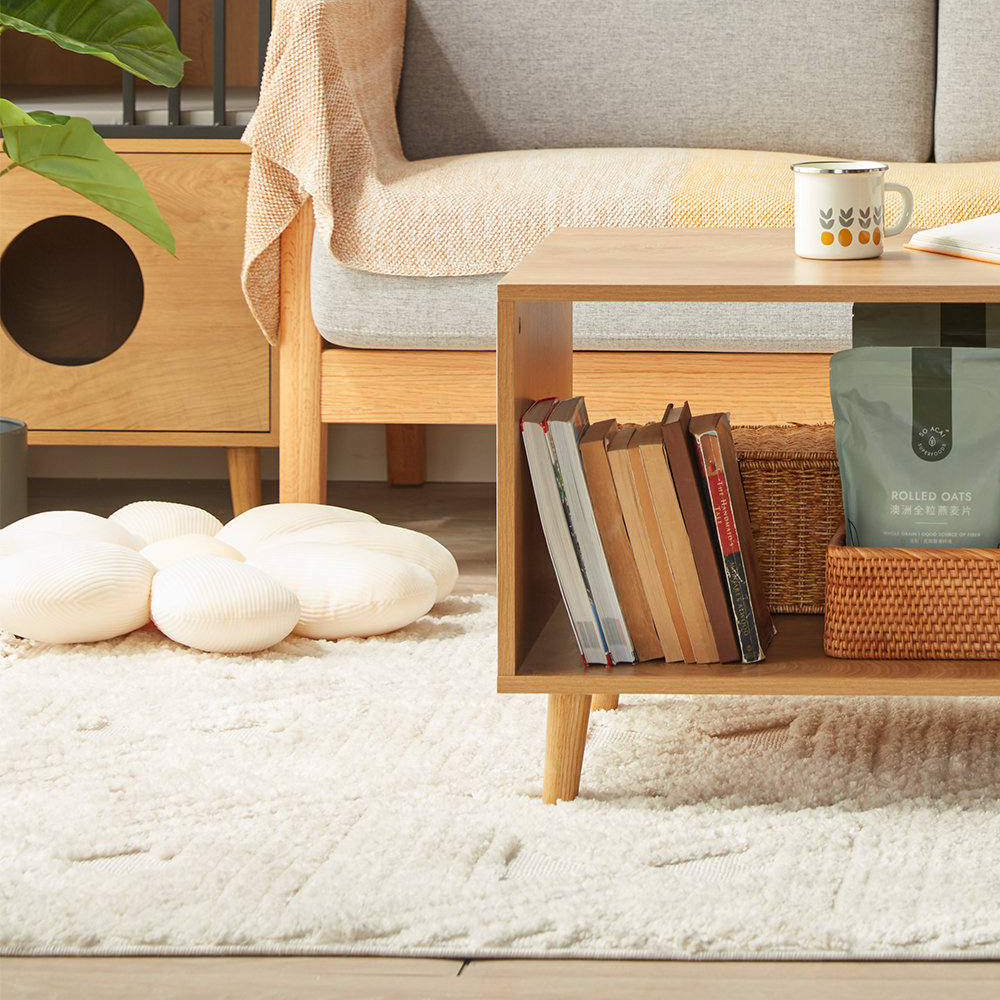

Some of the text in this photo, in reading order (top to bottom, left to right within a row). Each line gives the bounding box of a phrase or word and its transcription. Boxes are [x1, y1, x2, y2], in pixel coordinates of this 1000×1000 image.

[918, 428, 928, 437] SO
[891, 491, 972, 502] ROLLED OATS
[714, 507, 722, 525] TALE
[890, 504, 972, 517] 澳洲全粒燕麦片
